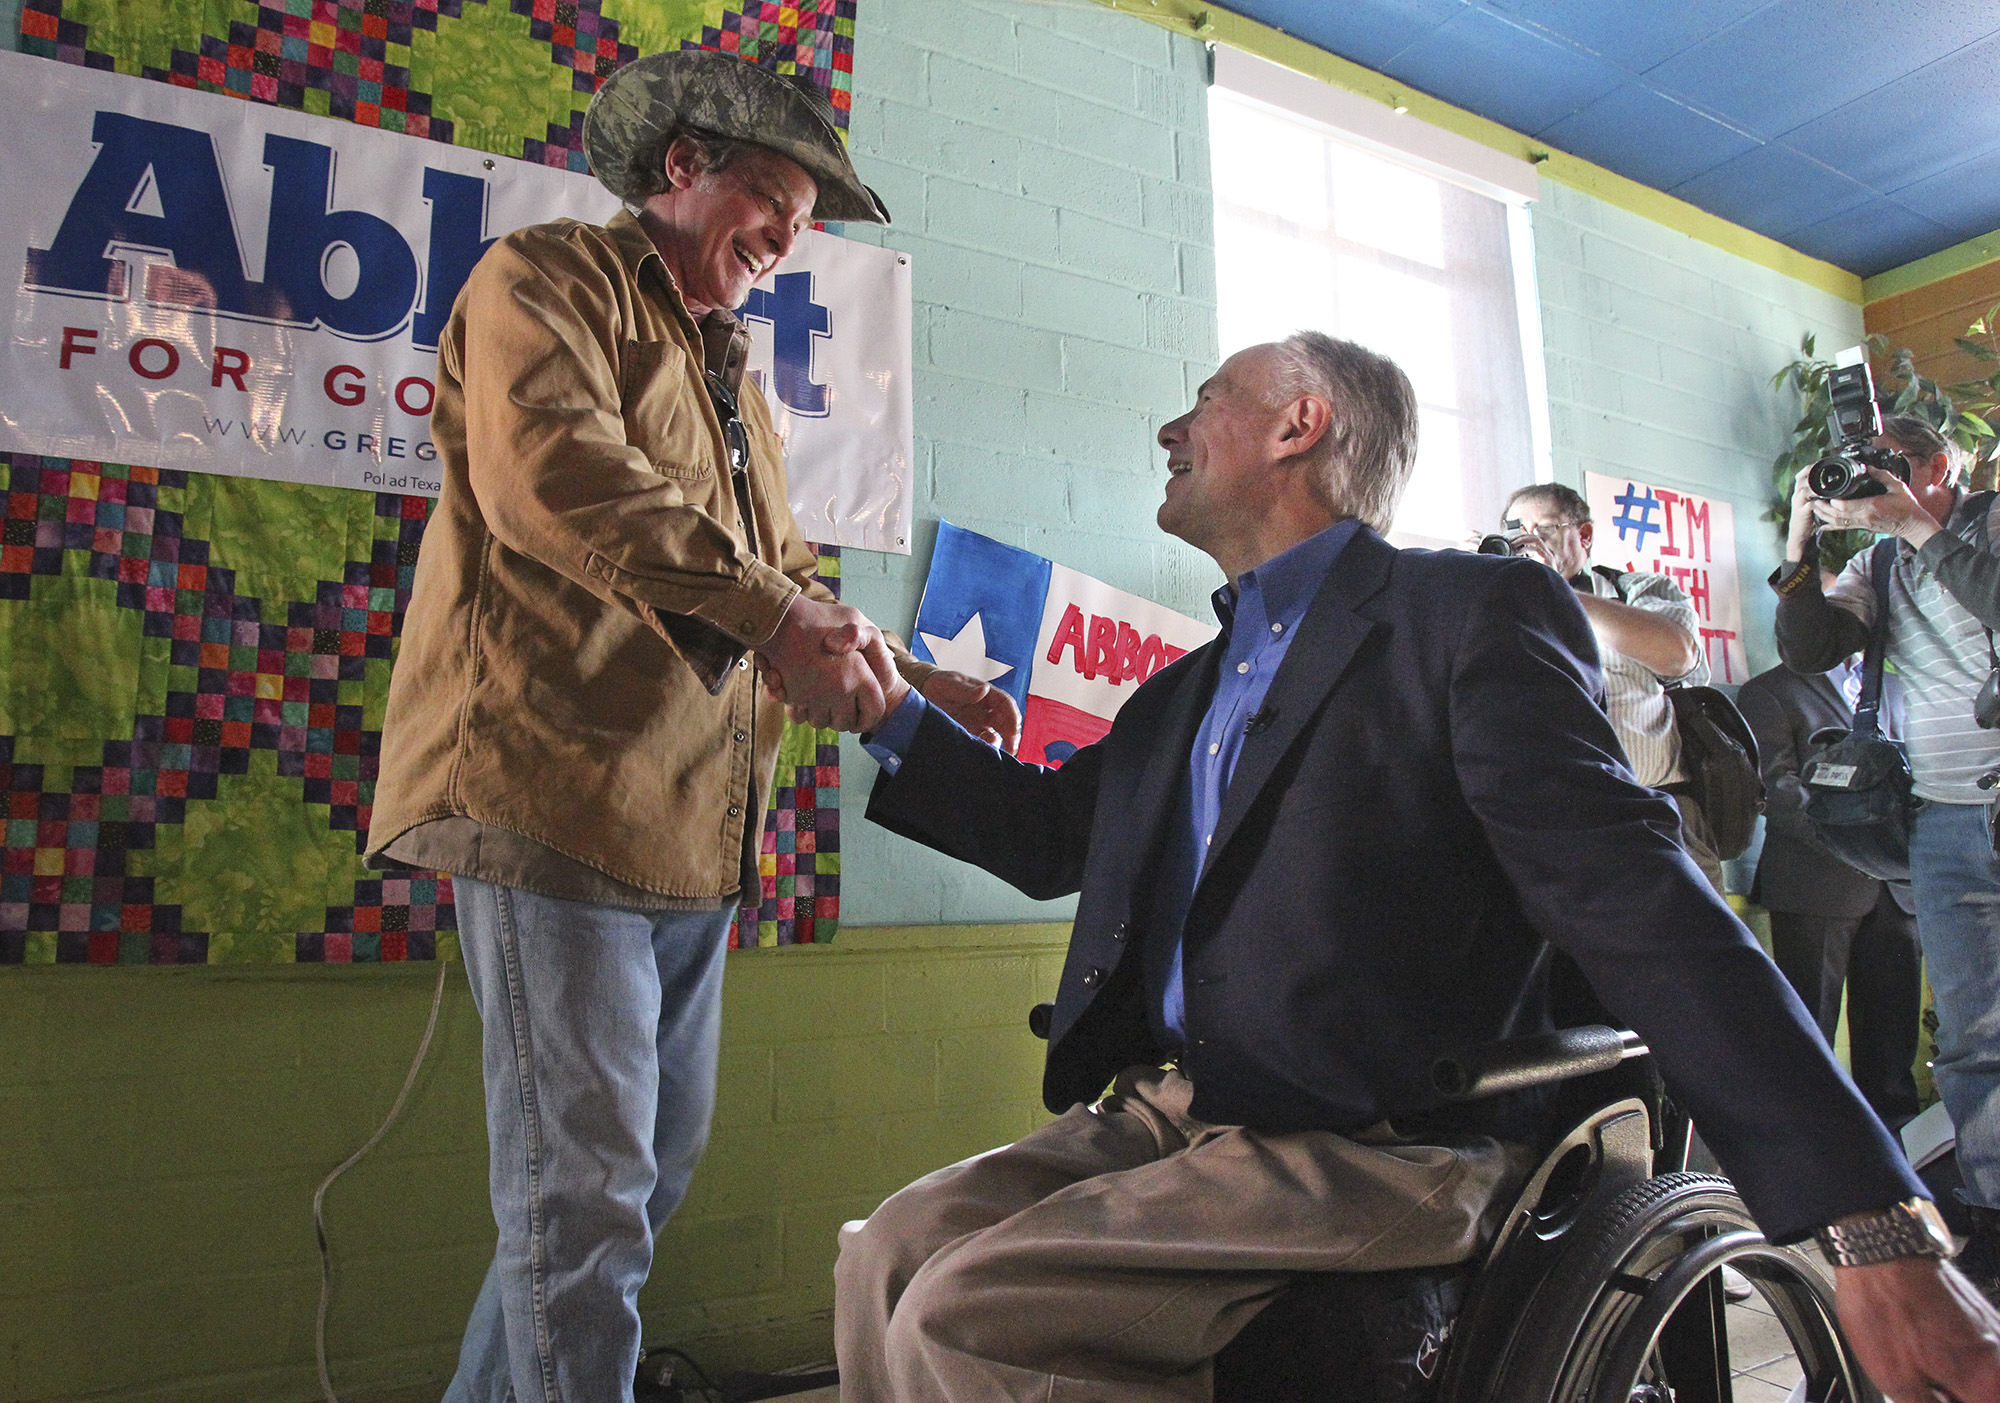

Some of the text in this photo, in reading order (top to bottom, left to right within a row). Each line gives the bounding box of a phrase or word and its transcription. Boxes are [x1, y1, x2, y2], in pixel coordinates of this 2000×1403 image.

[59, 326, 249, 393] FOR
[364, 471, 442, 492] Pol ad Texa
[1612, 482, 1711, 563] #I'M
[1626, 559, 1711, 622] TH
